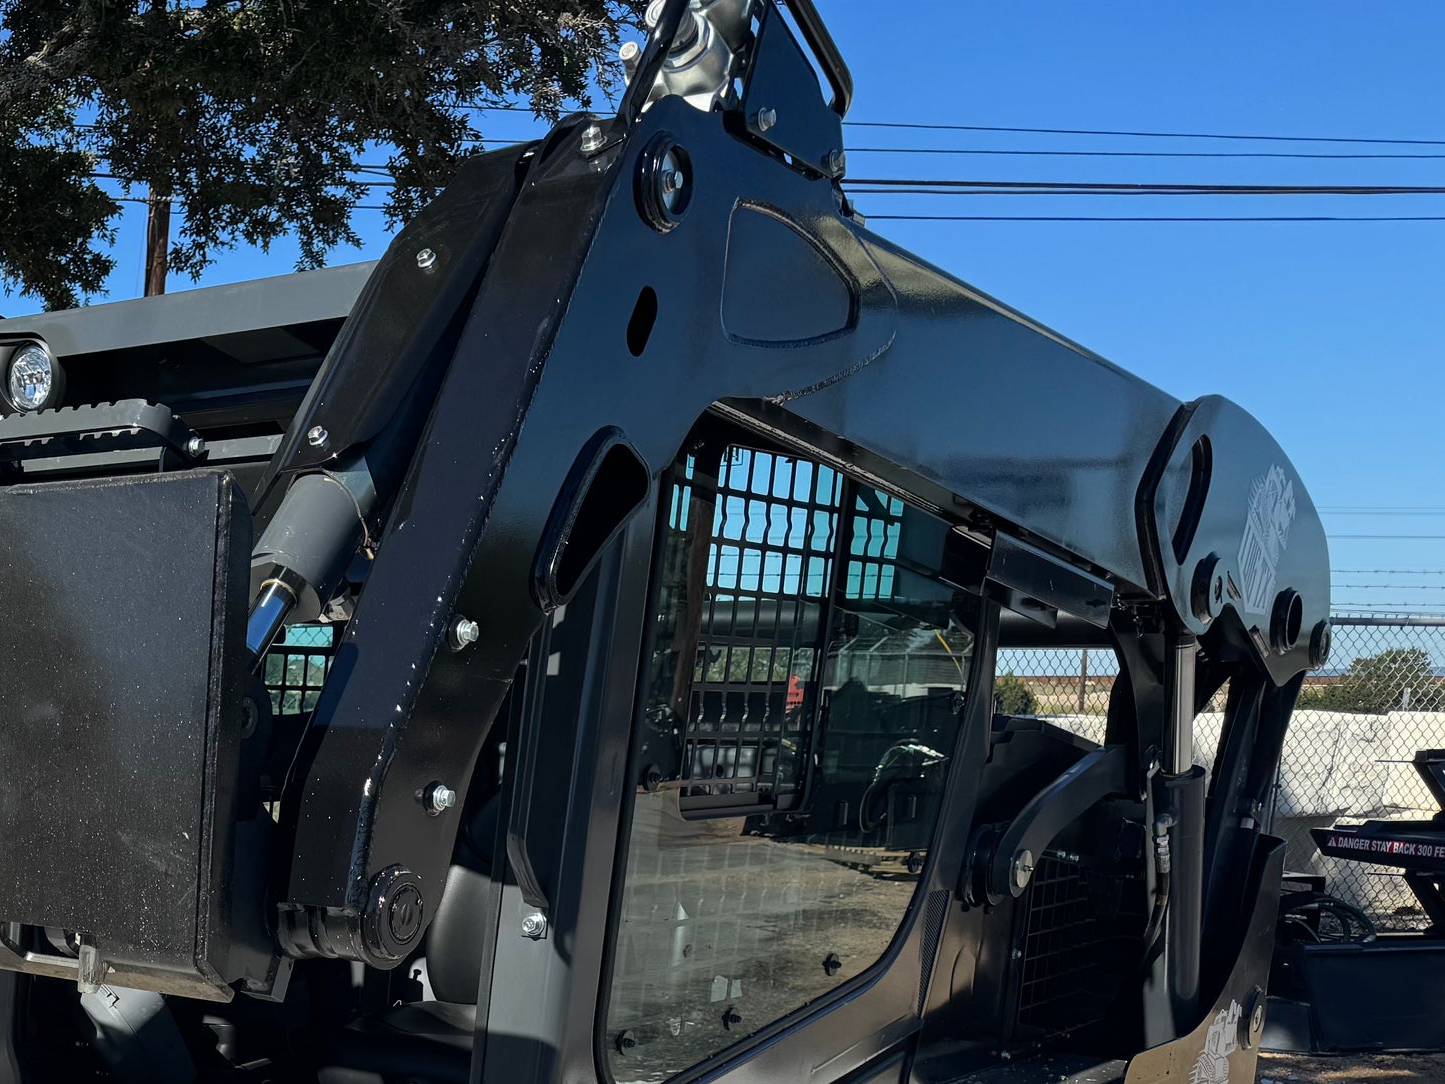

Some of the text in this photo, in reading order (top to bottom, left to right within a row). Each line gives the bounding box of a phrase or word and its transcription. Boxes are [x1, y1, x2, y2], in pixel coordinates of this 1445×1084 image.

[1338, 837, 1370, 850] DANGER
[1371, 840, 1392, 853] STAY
[1392, 841, 1416, 856] BACK
[1417, 845, 1433, 857] 300
